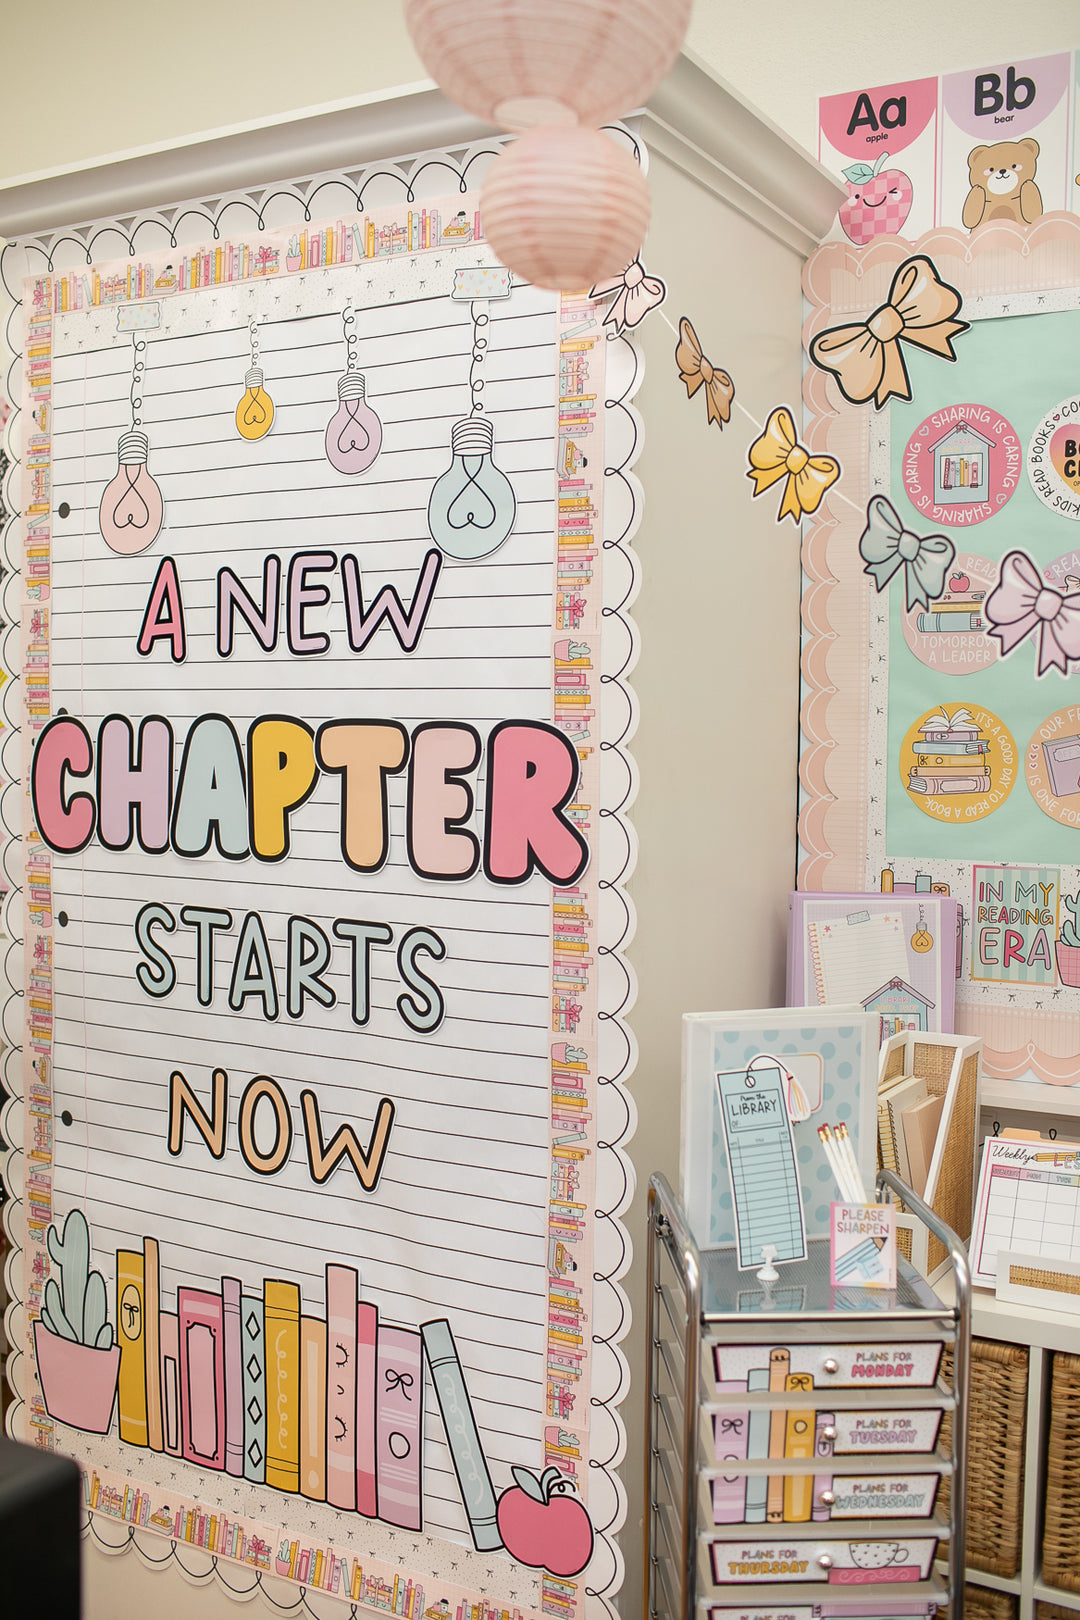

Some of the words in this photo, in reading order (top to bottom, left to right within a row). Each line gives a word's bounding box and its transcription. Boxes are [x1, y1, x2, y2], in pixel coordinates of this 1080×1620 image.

[974, 66, 1036, 117] Bb
[847, 93, 907, 136] Aa
[994, 114, 1015, 124] bear
[865, 132, 889, 144] apple
[931, 407, 991, 429] SHARING
[993, 420, 1007, 434] IS
[1002, 436, 1019, 489] CARING
[1031, 420, 1056, 463] BOOKS
[905, 443, 922, 494] CARING
[1033, 469, 1055, 498] READ
[917, 495, 932, 509] IS
[933, 502, 992, 523] SHARING
[137, 556, 187, 663] A
[216, 549, 442, 658] NEW
[929, 651, 936, 663] A
[943, 650, 991, 663] LEADER
[975, 712, 993, 728] IT'S
[1040, 716, 1065, 739] OUR
[991, 726, 1001, 736] A
[997, 735, 1013, 765] GOOD
[998, 767, 1013, 789] DAY
[32, 713, 590, 888] CHAPTER
[988, 788, 1005, 803] TO
[1029, 774, 1041, 786] IS
[1036, 788, 1059, 812] ONE
[925, 796, 951, 817] BOOK
[954, 808, 961, 818] A
[965, 799, 990, 817] READ
[979, 880, 1003, 902] IN
[1014, 881, 1054, 906] MY
[977, 906, 1054, 926] READING
[979, 928, 1051, 970] ERA
[135, 902, 446, 1034] STARTS
[731, 1099, 777, 1116] LIBRARY
[167, 1068, 396, 1192] NOW
[992, 1145, 1032, 1166] Weekly
[842, 1208, 885, 1222] PLEASE
[837, 1221, 890, 1234] SHARPEN
[856, 1352, 889, 1362] PLANS
[893, 1351, 912, 1361] FOR
[851, 1363, 914, 1378] MONDAY
[856, 1419, 889, 1429] PLANS
[893, 1419, 912, 1428] FOR
[849, 1430, 917, 1444] TUESDAY
[852, 1483, 886, 1493] PLANS
[889, 1483, 908, 1493] FOR
[834, 1495, 924, 1509] WEDNESDAY
[741, 1550, 775, 1560] PLANS
[778, 1549, 797, 1559] FOR
[727, 1560, 809, 1575] THURSDAY
